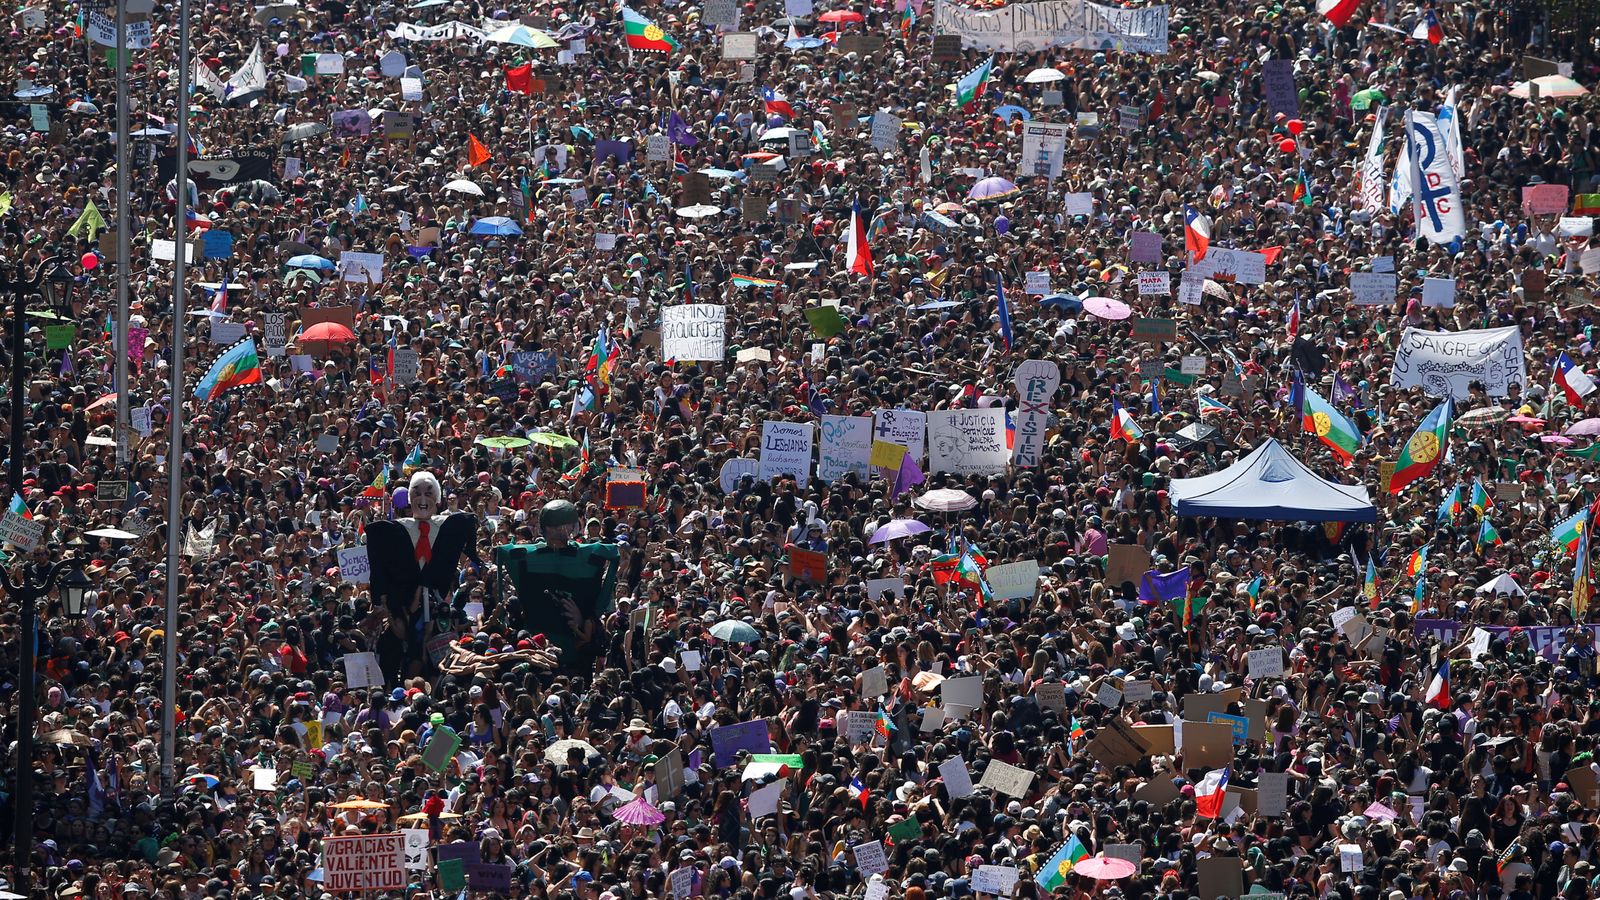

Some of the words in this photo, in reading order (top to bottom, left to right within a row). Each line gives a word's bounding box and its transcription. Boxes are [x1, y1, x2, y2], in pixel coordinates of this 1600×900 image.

[237, 149, 251, 158] LOS
[1427, 172, 1441, 188] D
[1437, 197, 1452, 214] C
[265, 313, 284, 325] LOS
[688, 339, 724, 359] VALIENT
[1411, 331, 1478, 358] SANGRE
[517, 352, 546, 364] LUCHA
[326, 870, 402, 889] JUVENTUD
